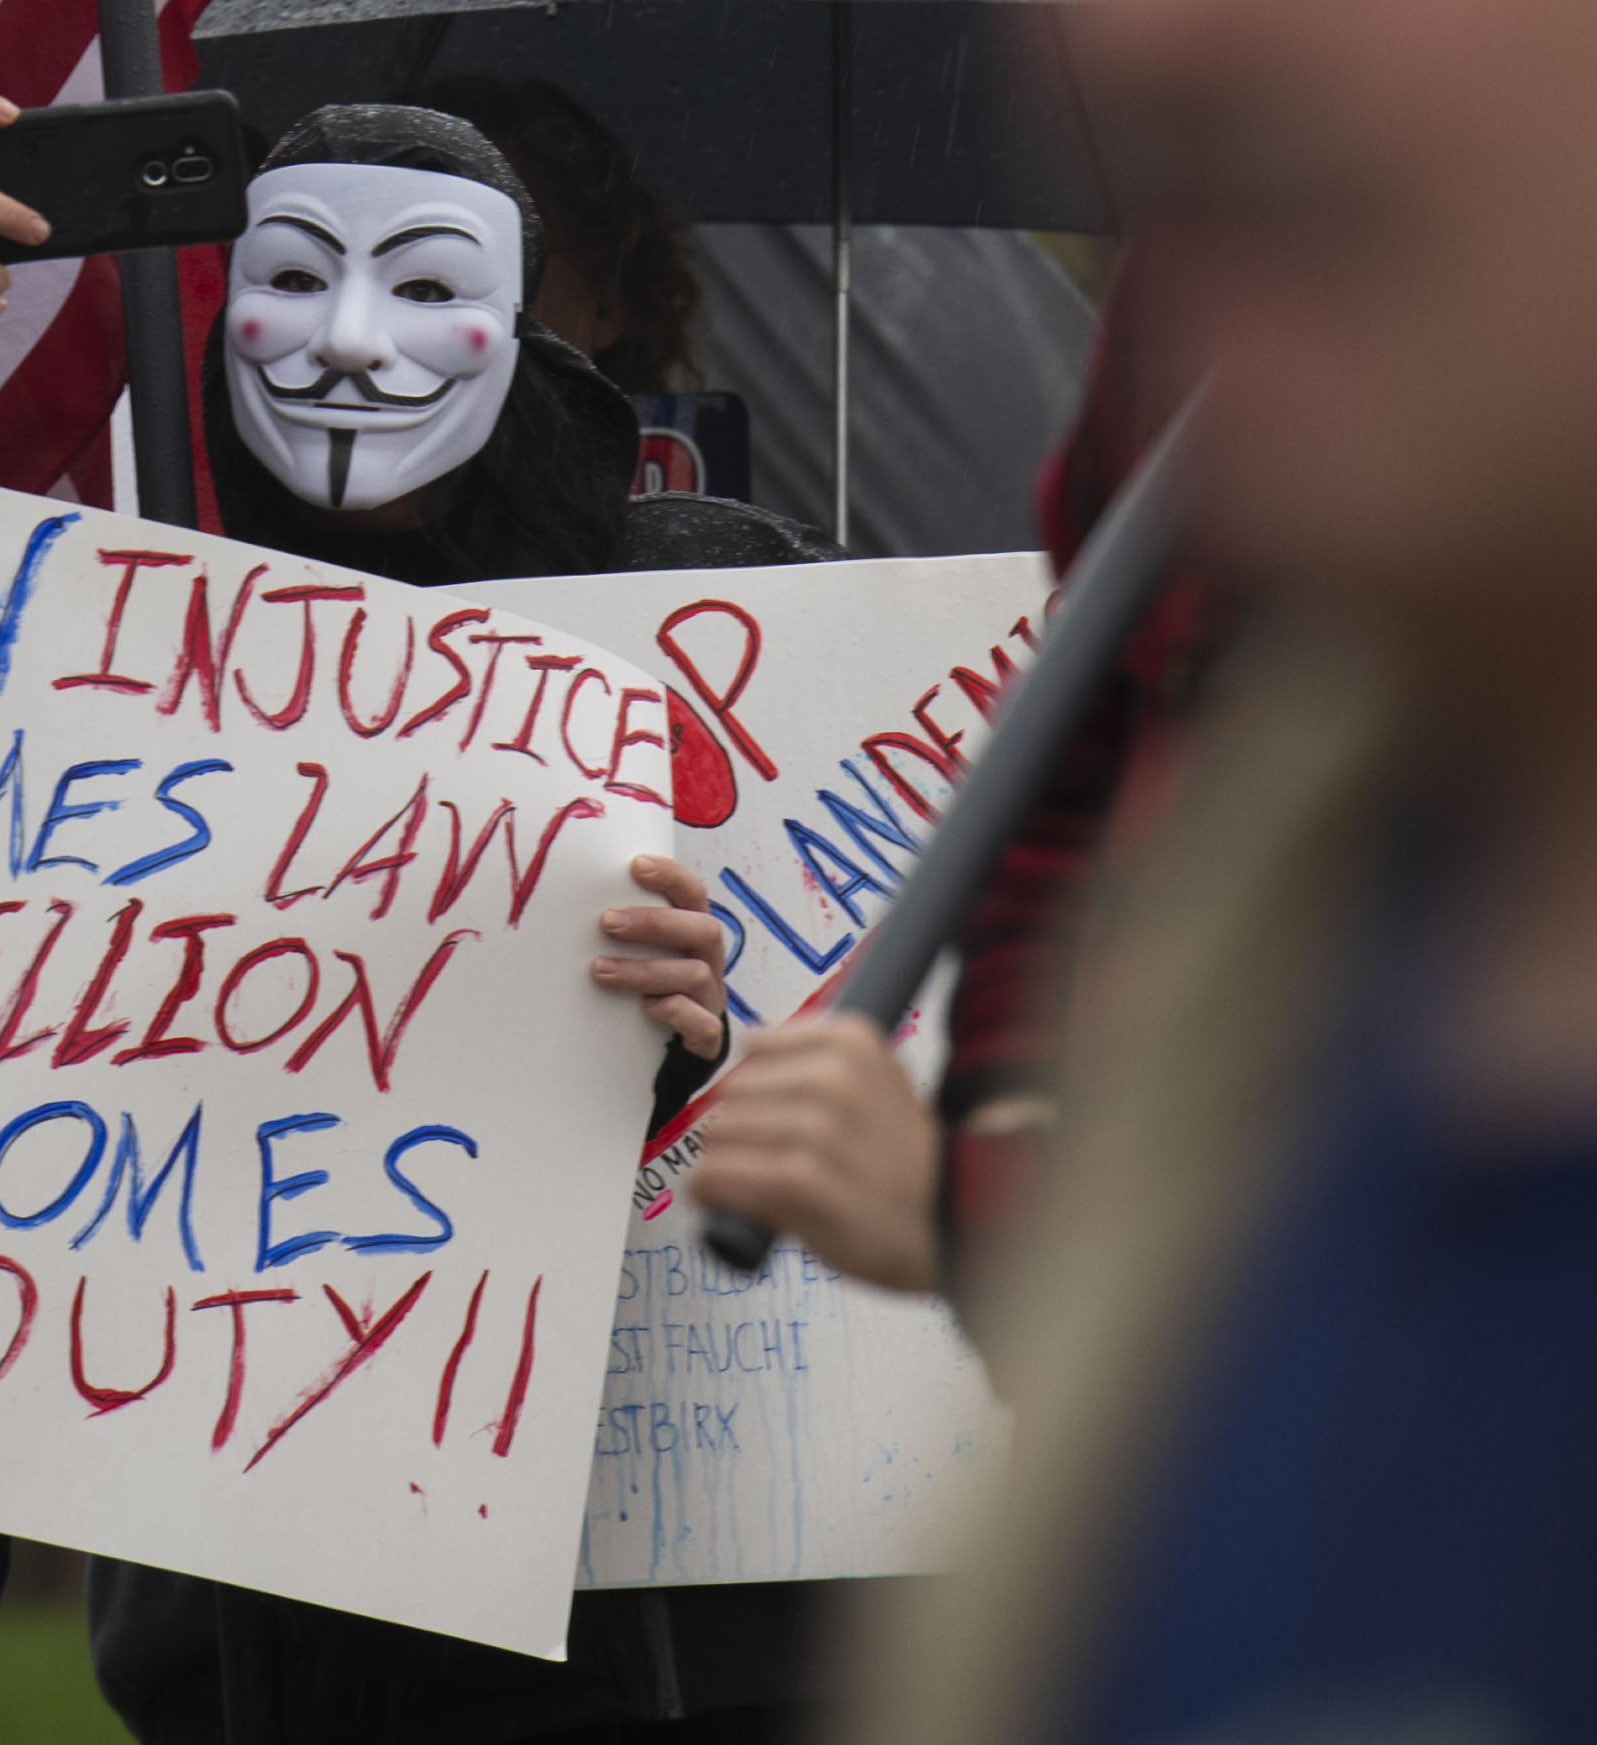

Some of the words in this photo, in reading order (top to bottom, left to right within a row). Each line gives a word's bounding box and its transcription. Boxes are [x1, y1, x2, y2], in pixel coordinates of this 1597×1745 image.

[50, 548, 672, 810] INJUSTICE
[264, 760, 606, 928] LAW
[708, 587, 1062, 1027] PLANDEM
[607, 1327, 651, 1373] ST
[662, 1320, 809, 1373] FAUCHI
